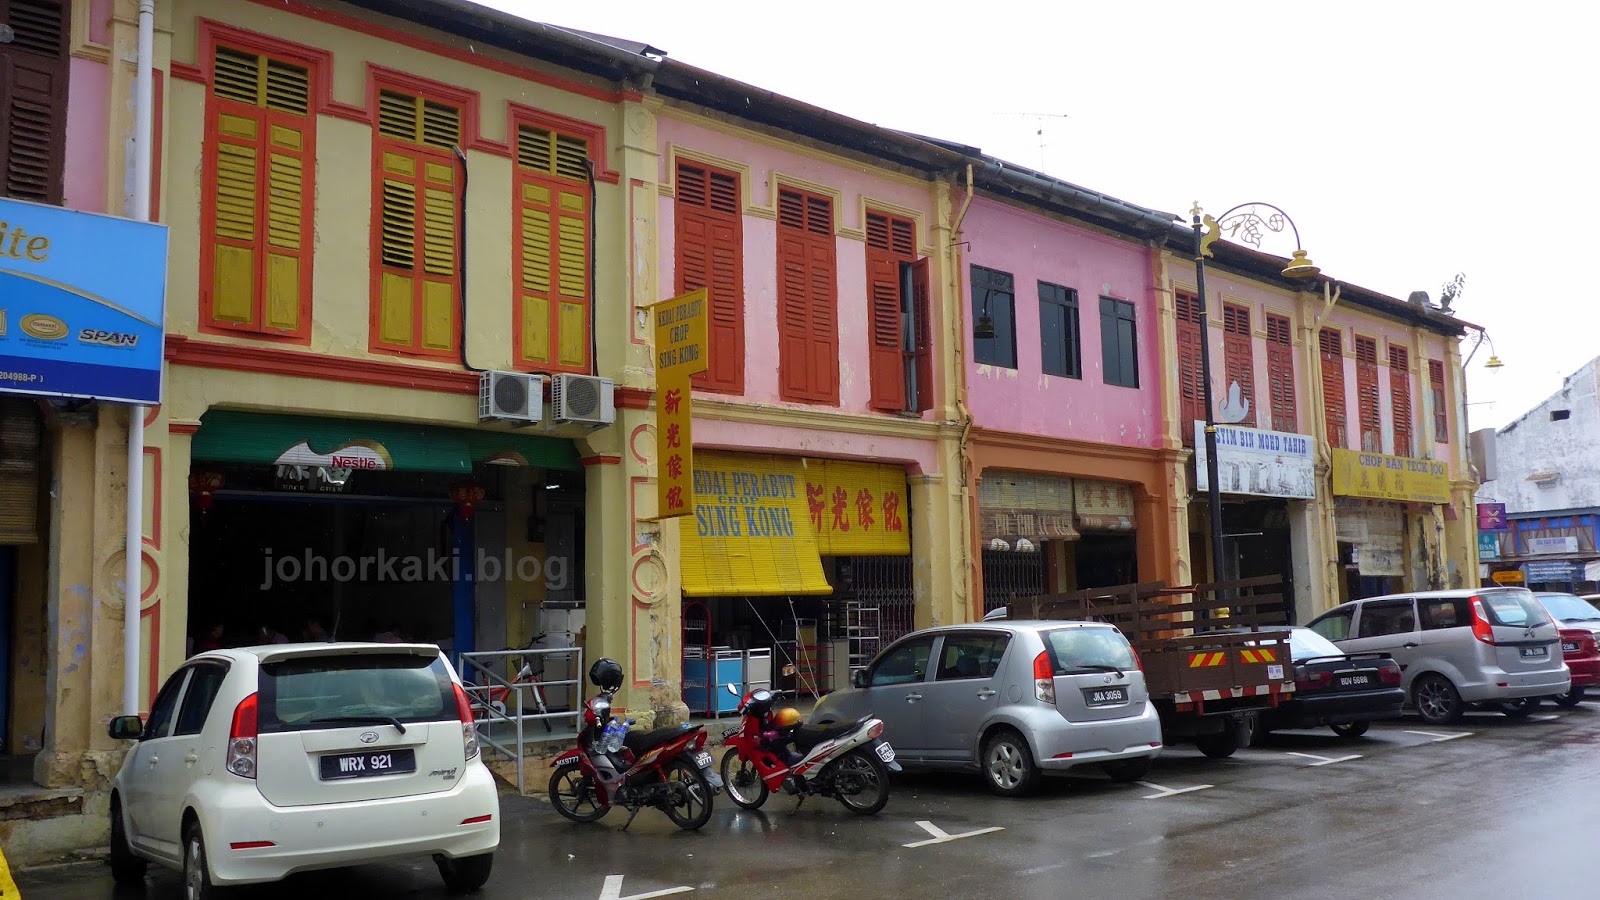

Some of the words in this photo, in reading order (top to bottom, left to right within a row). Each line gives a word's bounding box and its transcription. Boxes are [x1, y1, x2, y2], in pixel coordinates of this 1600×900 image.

[658, 308, 675, 327] KEDAI
[676, 299, 702, 322] PERABUT
[80, 329, 137, 344] SPAN
[669, 323, 690, 344] CHOP
[659, 349, 677, 369] SING
[679, 343, 699, 364] KONG
[1240, 431, 1254, 448] BIN
[1258, 433, 1280, 451] MOHD
[1283, 437, 1307, 455] TAHIR
[1359, 454, 1382, 467] CHOP
[1386, 458, 1403, 470] BAN
[1407, 461, 1428, 473] TECK
[1430, 463, 1444, 476] JOO
[693, 470, 727, 495] EDAI
[732, 471, 796, 499] PERABUT
[718, 496, 759, 504] CHOP
[696, 505, 741, 537] SING
[744, 506, 794, 537] KONG
[1093, 692, 1106, 701] JKA
[1106, 690, 1122, 700] 3059
[339, 757, 366, 772] WRX
[370, 754, 392, 769] 921
